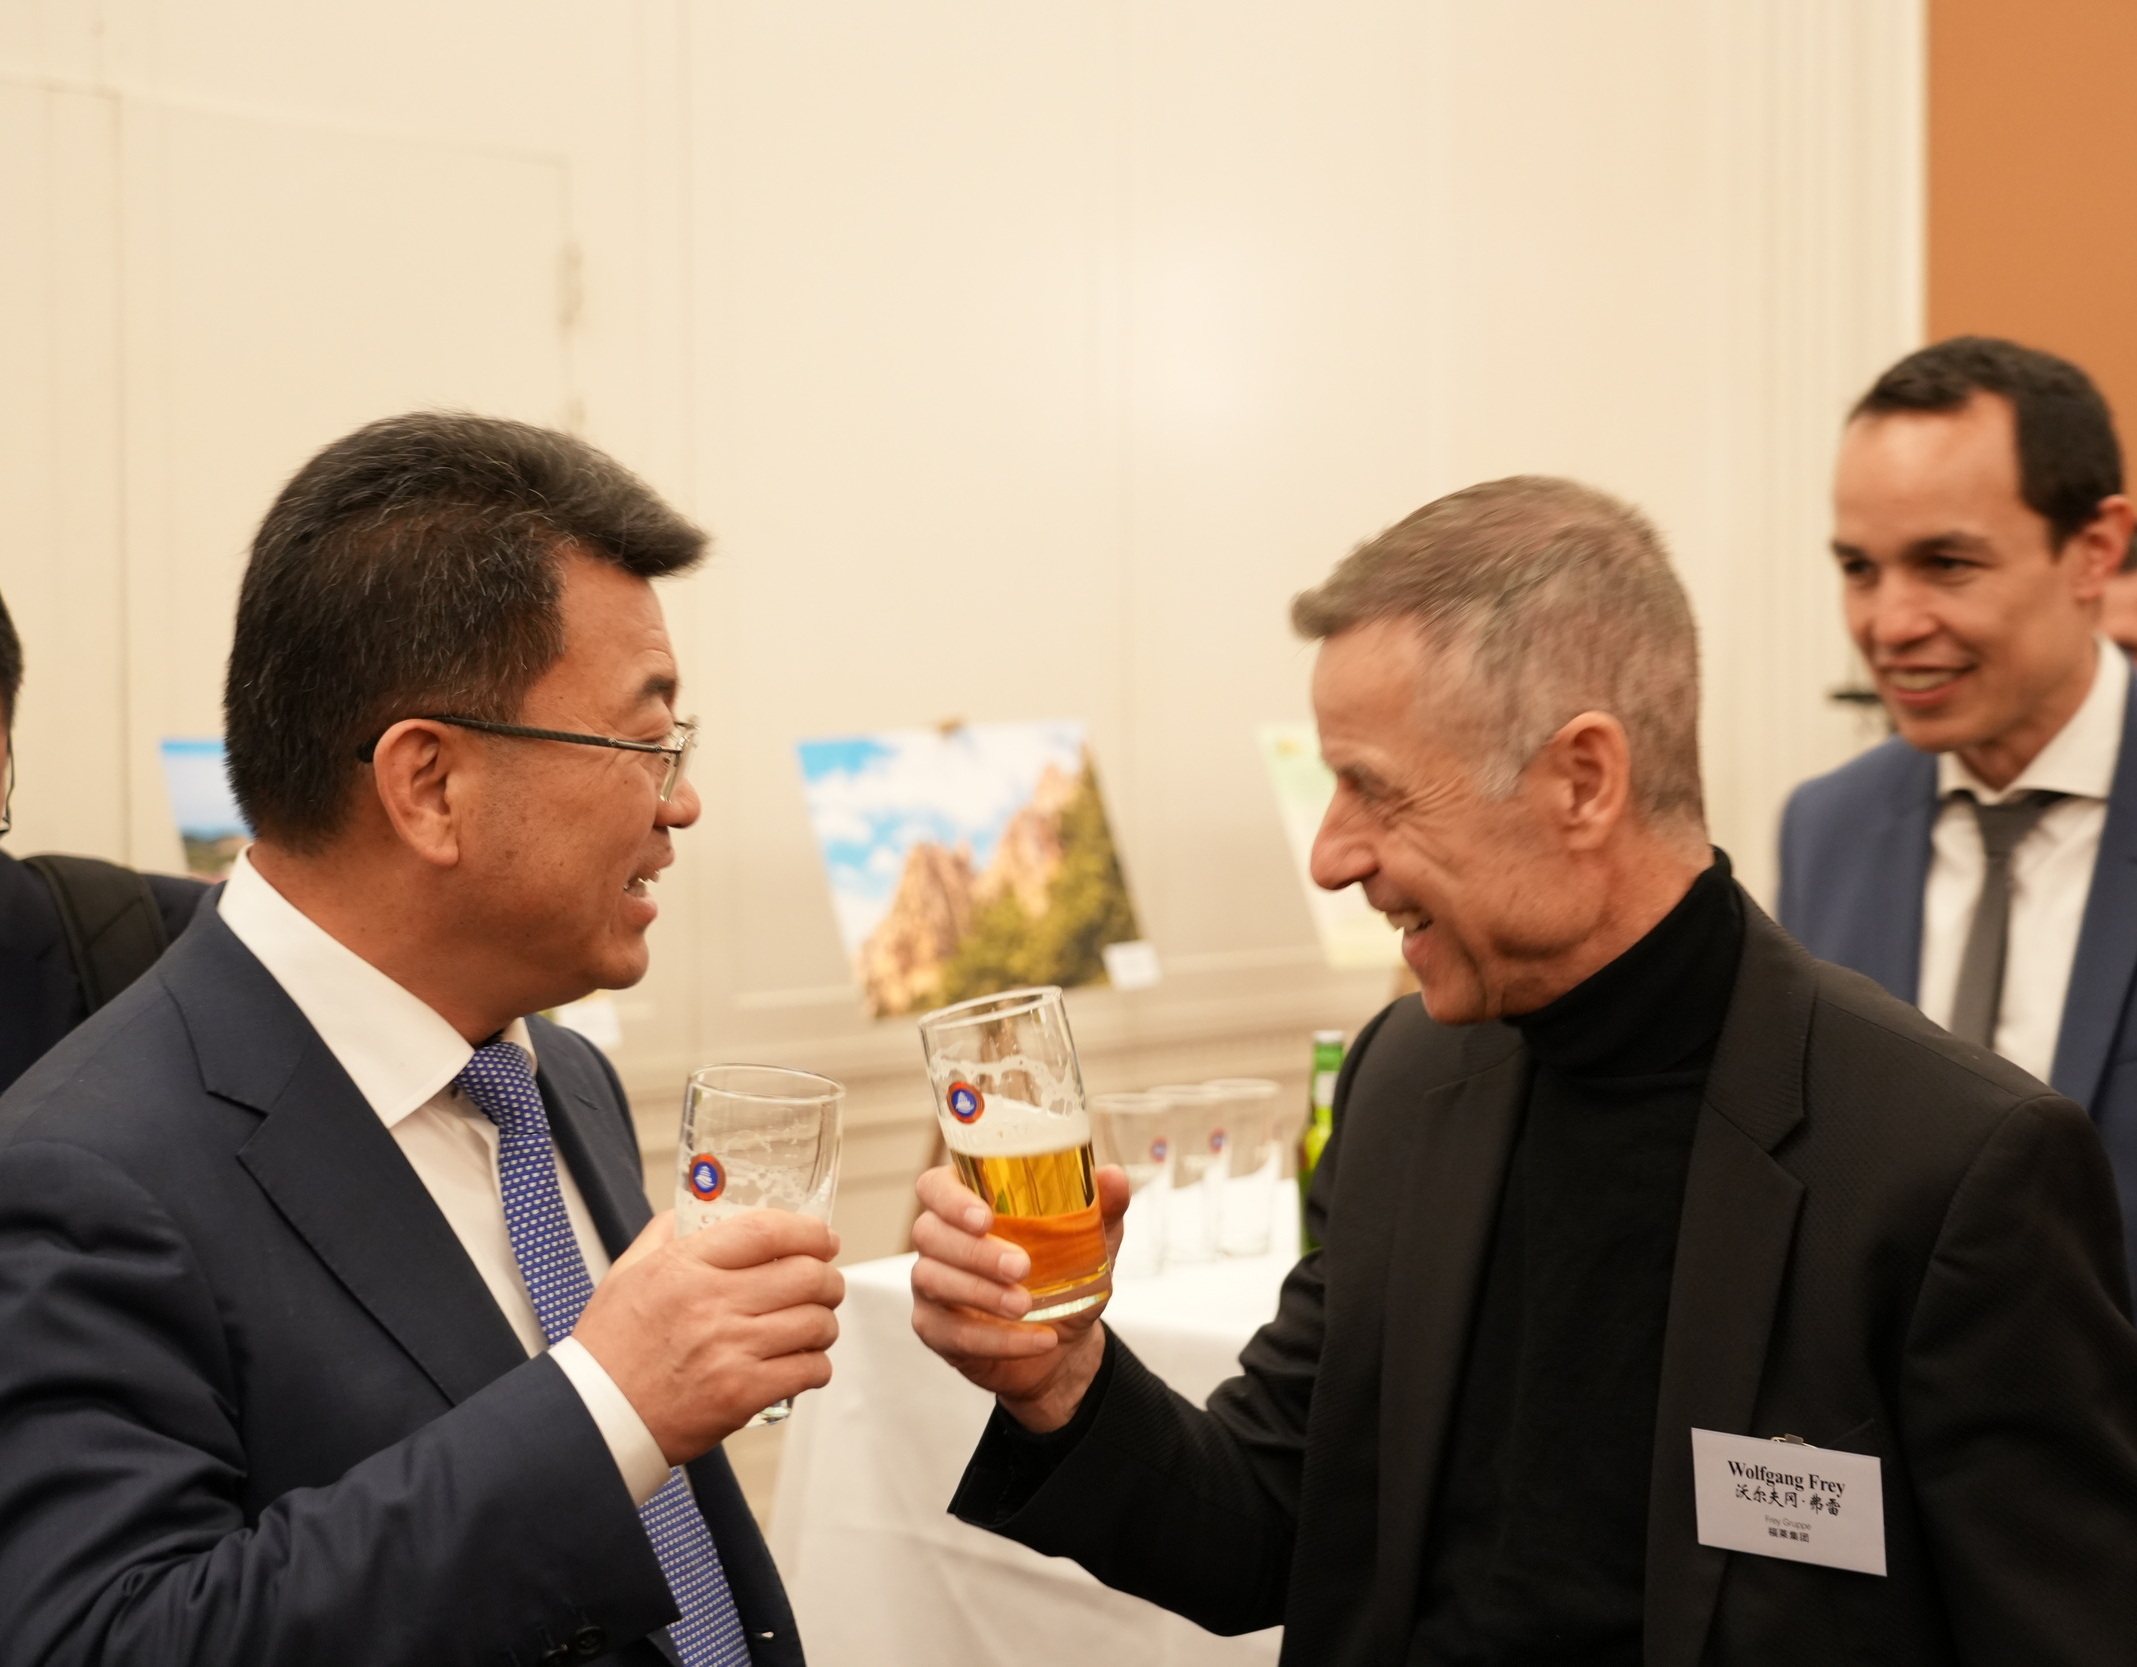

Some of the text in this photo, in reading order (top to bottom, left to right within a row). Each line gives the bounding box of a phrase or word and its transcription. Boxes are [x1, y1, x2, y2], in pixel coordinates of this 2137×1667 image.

[1728, 1460, 1846, 1498] Wolfgang Frey
[1783, 1517, 1811, 1531] Gruppe
